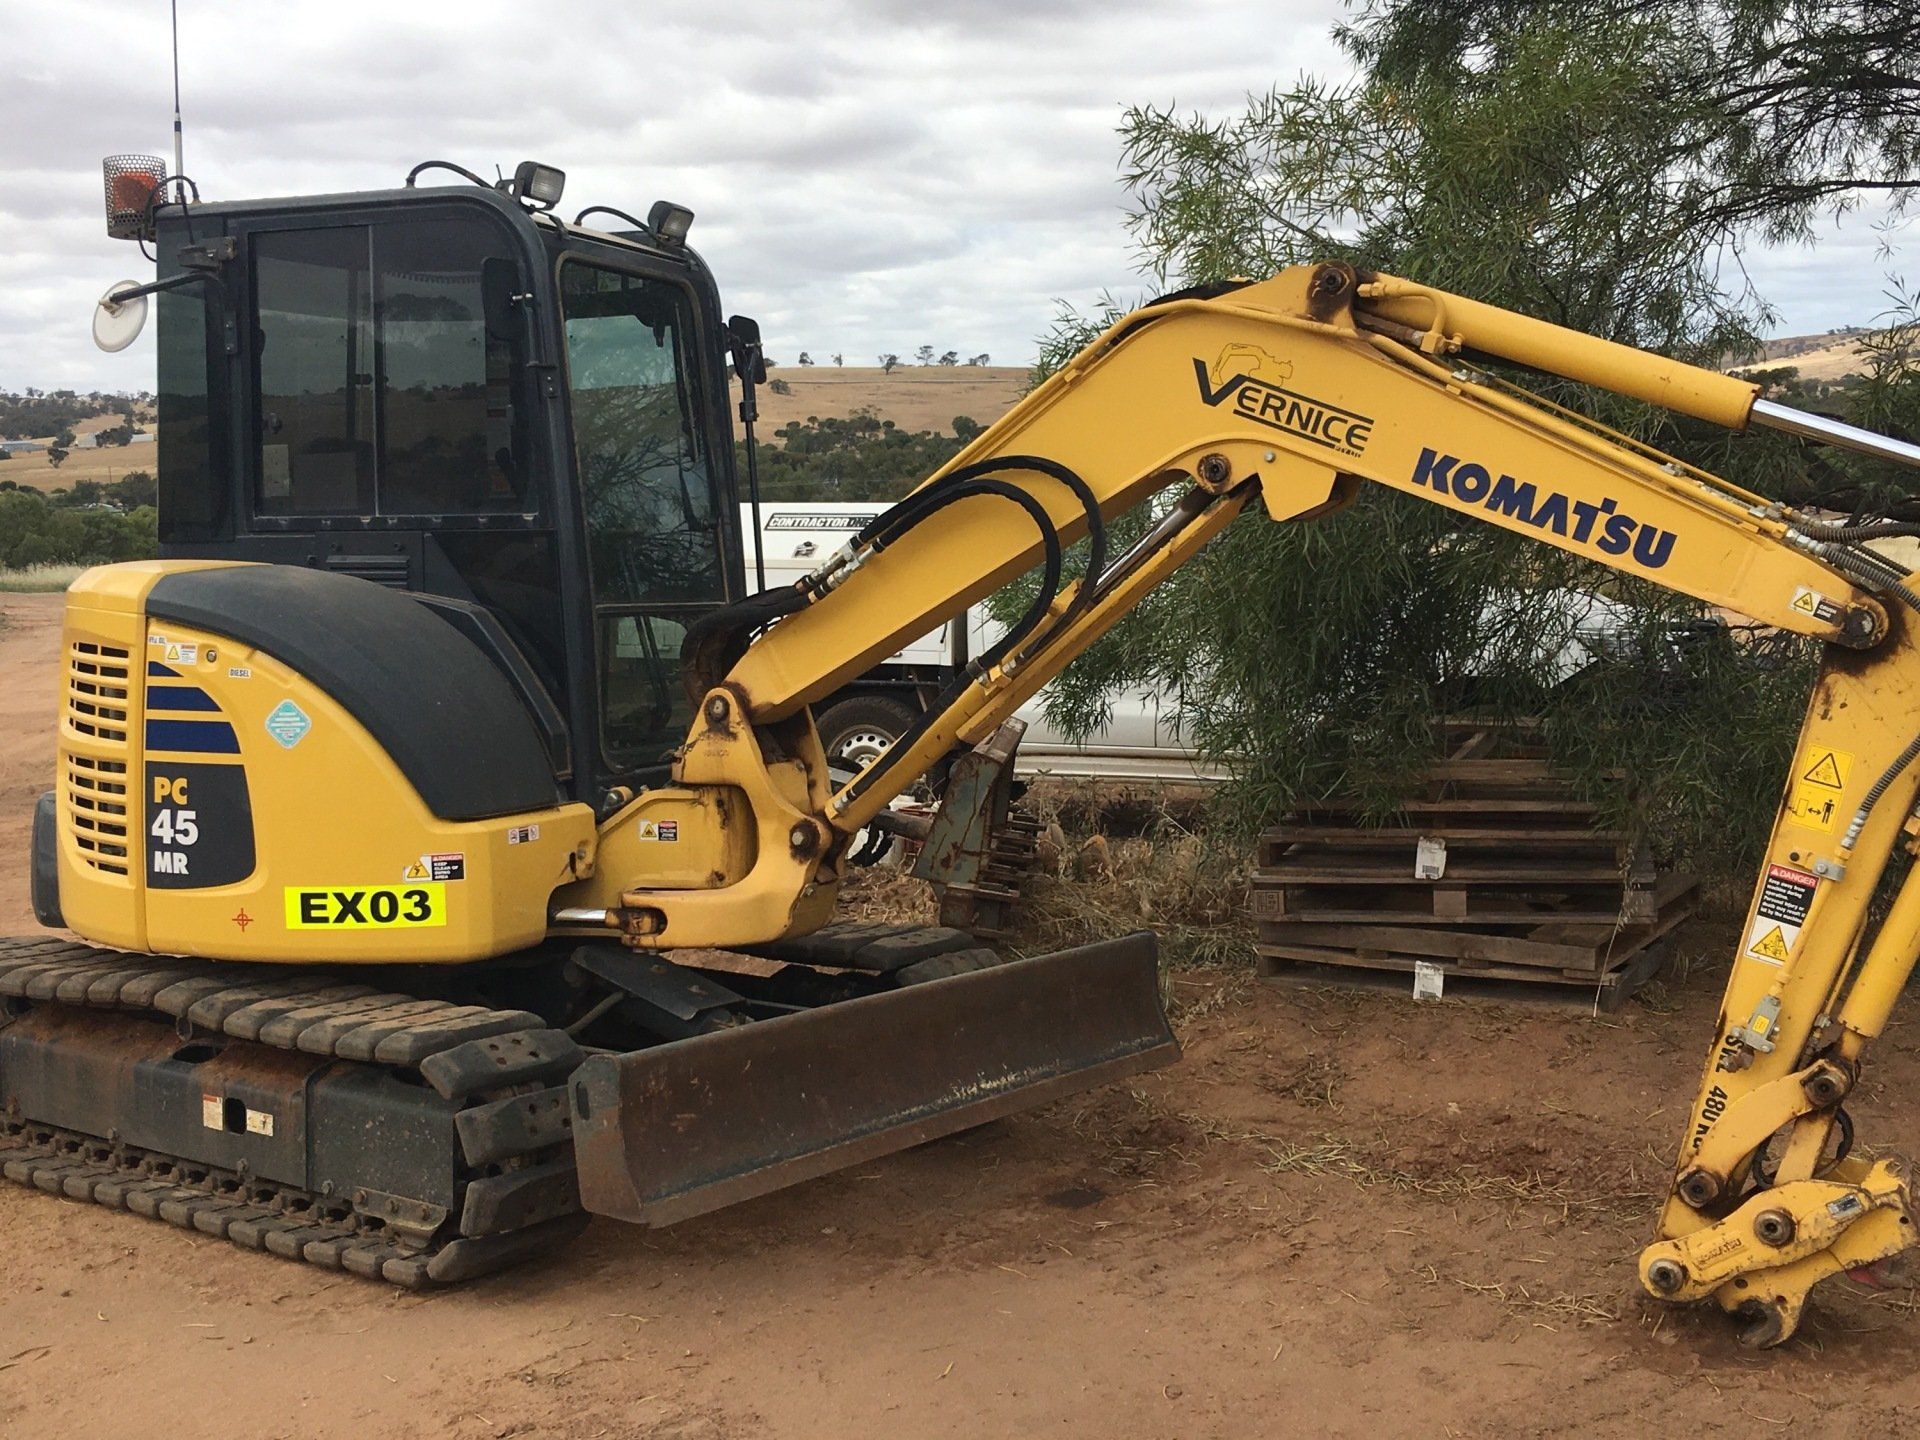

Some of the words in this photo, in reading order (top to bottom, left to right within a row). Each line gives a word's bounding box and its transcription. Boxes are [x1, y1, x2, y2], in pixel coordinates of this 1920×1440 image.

[1193, 357, 1373, 452] VERNICE
[1411, 447, 1678, 569] KOMATSU
[769, 517, 849, 527] CONTRACTOR
[230, 669, 249, 677] DIESEL
[154, 776, 188, 805] PC
[152, 809, 198, 845] 45
[154, 851, 189, 874] MR
[1767, 884, 1786, 893] machine
[1780, 870, 1816, 886] DANGER
[300, 890, 431, 923] EX03
[1764, 896, 1784, 905] Personal
